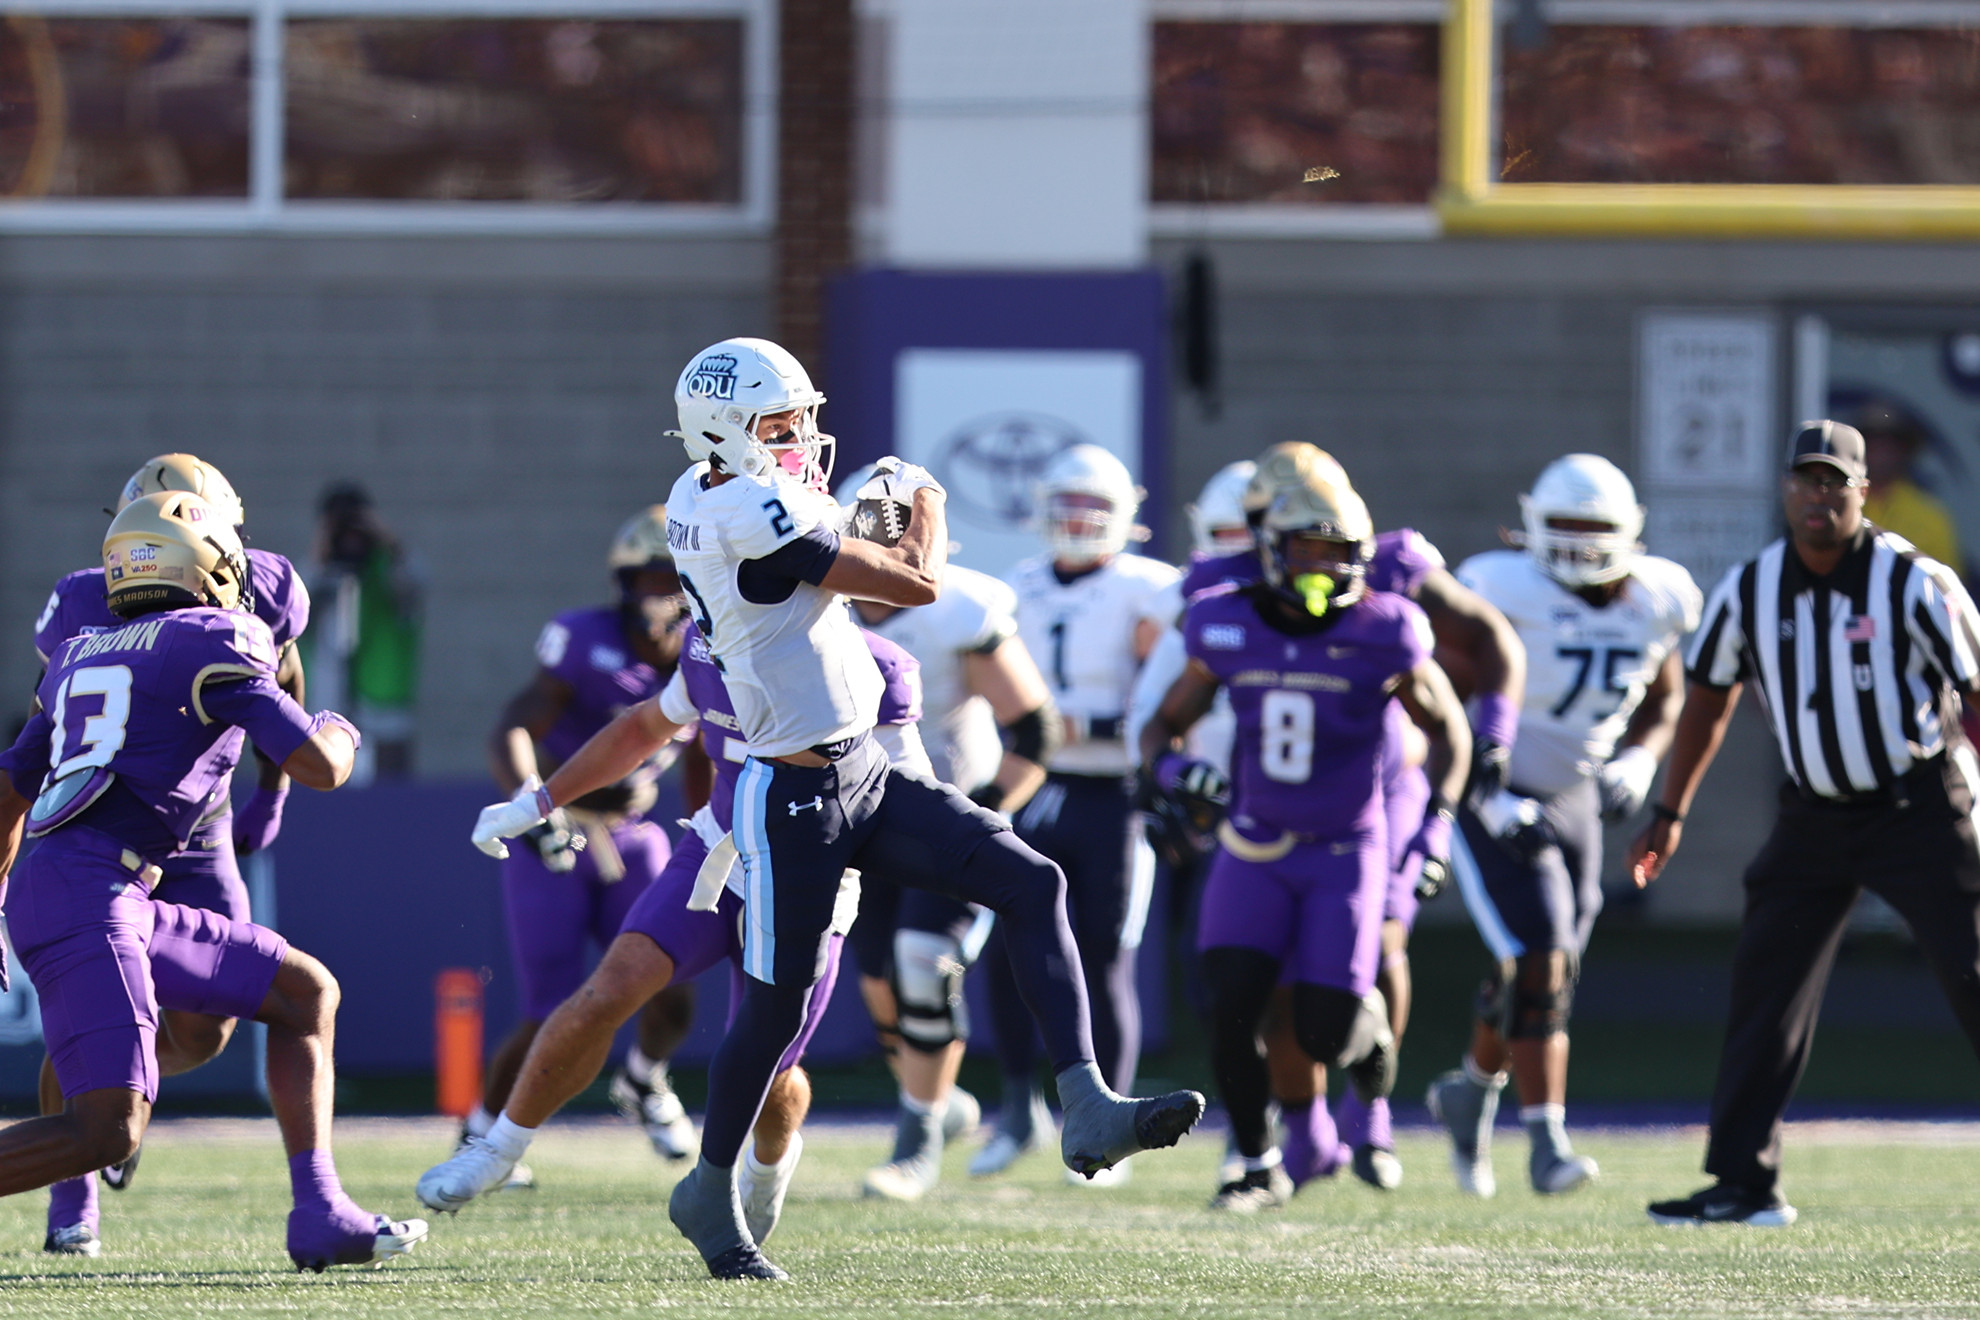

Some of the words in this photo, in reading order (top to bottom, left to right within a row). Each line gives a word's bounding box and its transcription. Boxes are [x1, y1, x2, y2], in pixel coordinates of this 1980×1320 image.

[688, 373, 736, 400] ODU
[760, 497, 796, 539] 2
[130, 547, 156, 562] SBC
[131, 564, 157, 573] VA250
[124, 589, 168, 602] MADISON
[76, 620, 165, 661] BROWN
[1050, 621, 1070, 691] 1
[1554, 647, 1640, 722] 75
[50, 665, 133, 780] 13
[1261, 690, 1314, 784] 8
